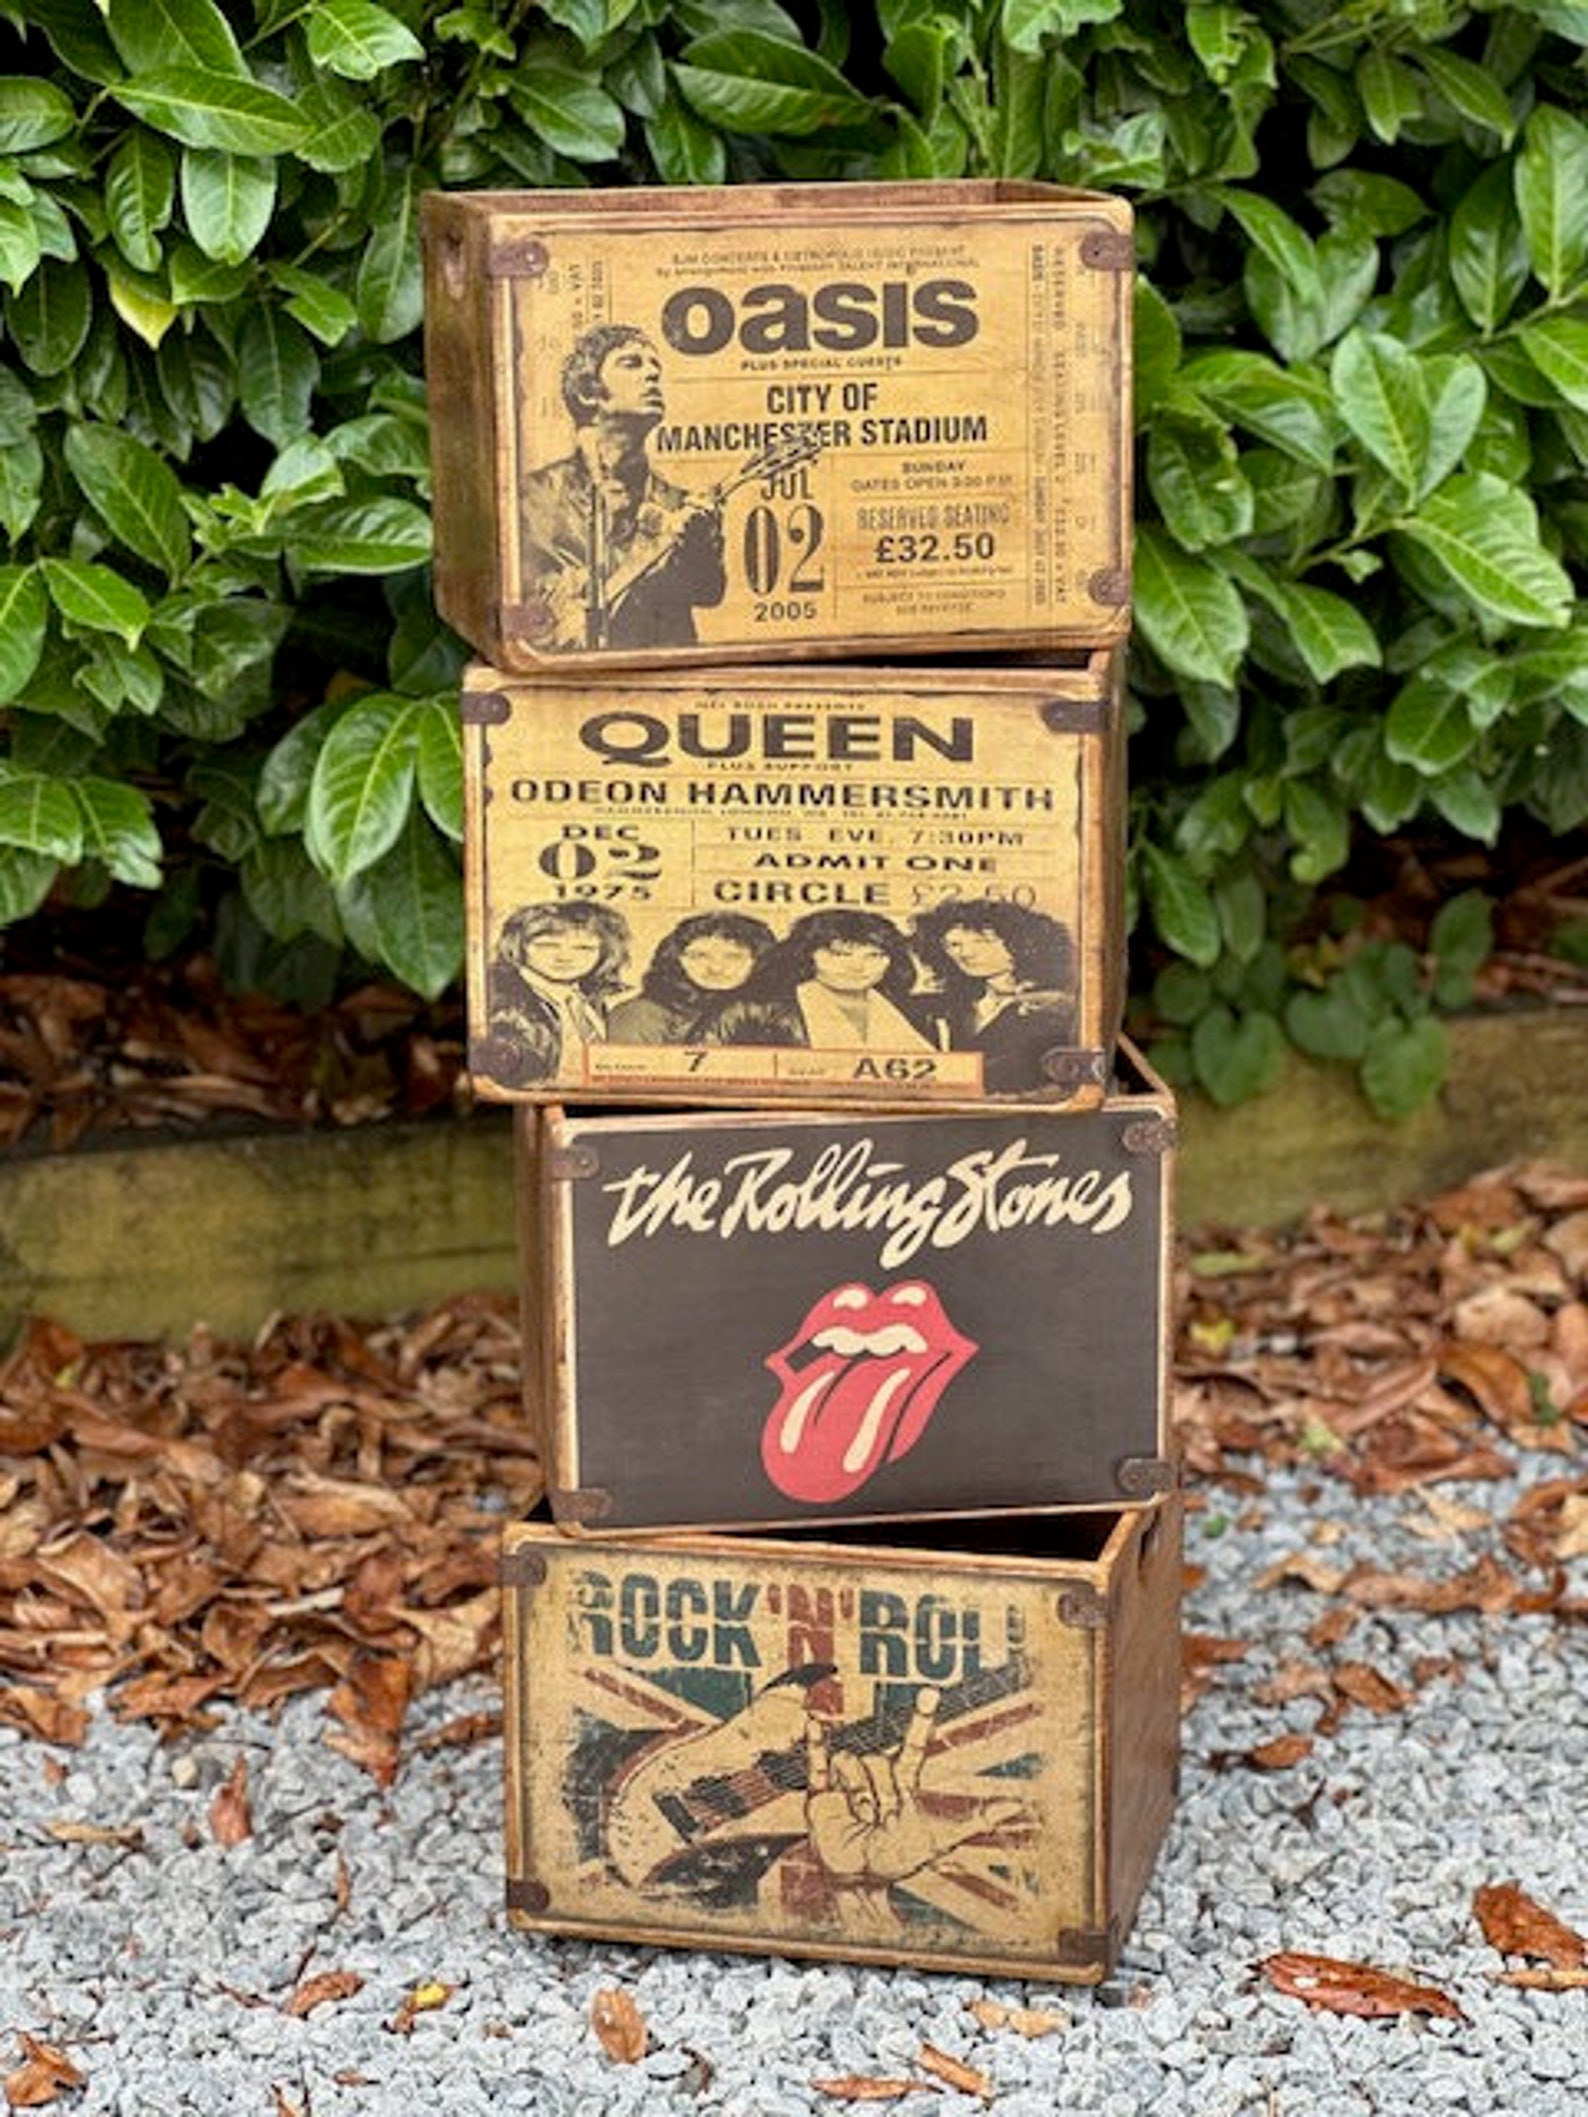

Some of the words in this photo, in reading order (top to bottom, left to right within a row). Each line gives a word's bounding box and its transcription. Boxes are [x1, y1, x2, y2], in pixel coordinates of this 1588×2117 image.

[661, 279, 979, 355] oasis
[766, 385, 832, 415] CITY
[842, 382, 878, 411] OF
[861, 415, 988, 446] STADIUM
[902, 460, 966, 474] SUNDAY
[760, 466, 814, 501] JUL
[743, 502, 825, 596] 02
[874, 532, 995, 563] £32.50
[753, 601, 817, 622] 2005
[579, 711, 974, 768] QUEEN
[511, 779, 668, 803] ODEON
[687, 782, 1055, 811] HAMMERSMITH
[562, 825, 640, 841] DEC
[727, 826, 802, 842] TUES
[910, 829, 1023, 846] 7:30PM
[539, 842, 661, 880] 02
[753, 853, 889, 870] ADMIT
[905, 856, 996, 873] ONE
[555, 883, 653, 900] 1975
[713, 880, 891, 906] CIRCLE
[684, 1051, 707, 1073] 7
[852, 1058, 938, 1081] A62
[602, 1151, 721, 1247] the
[721, 1138, 947, 1270] Rolling
[932, 1138, 1132, 1248] Stones
